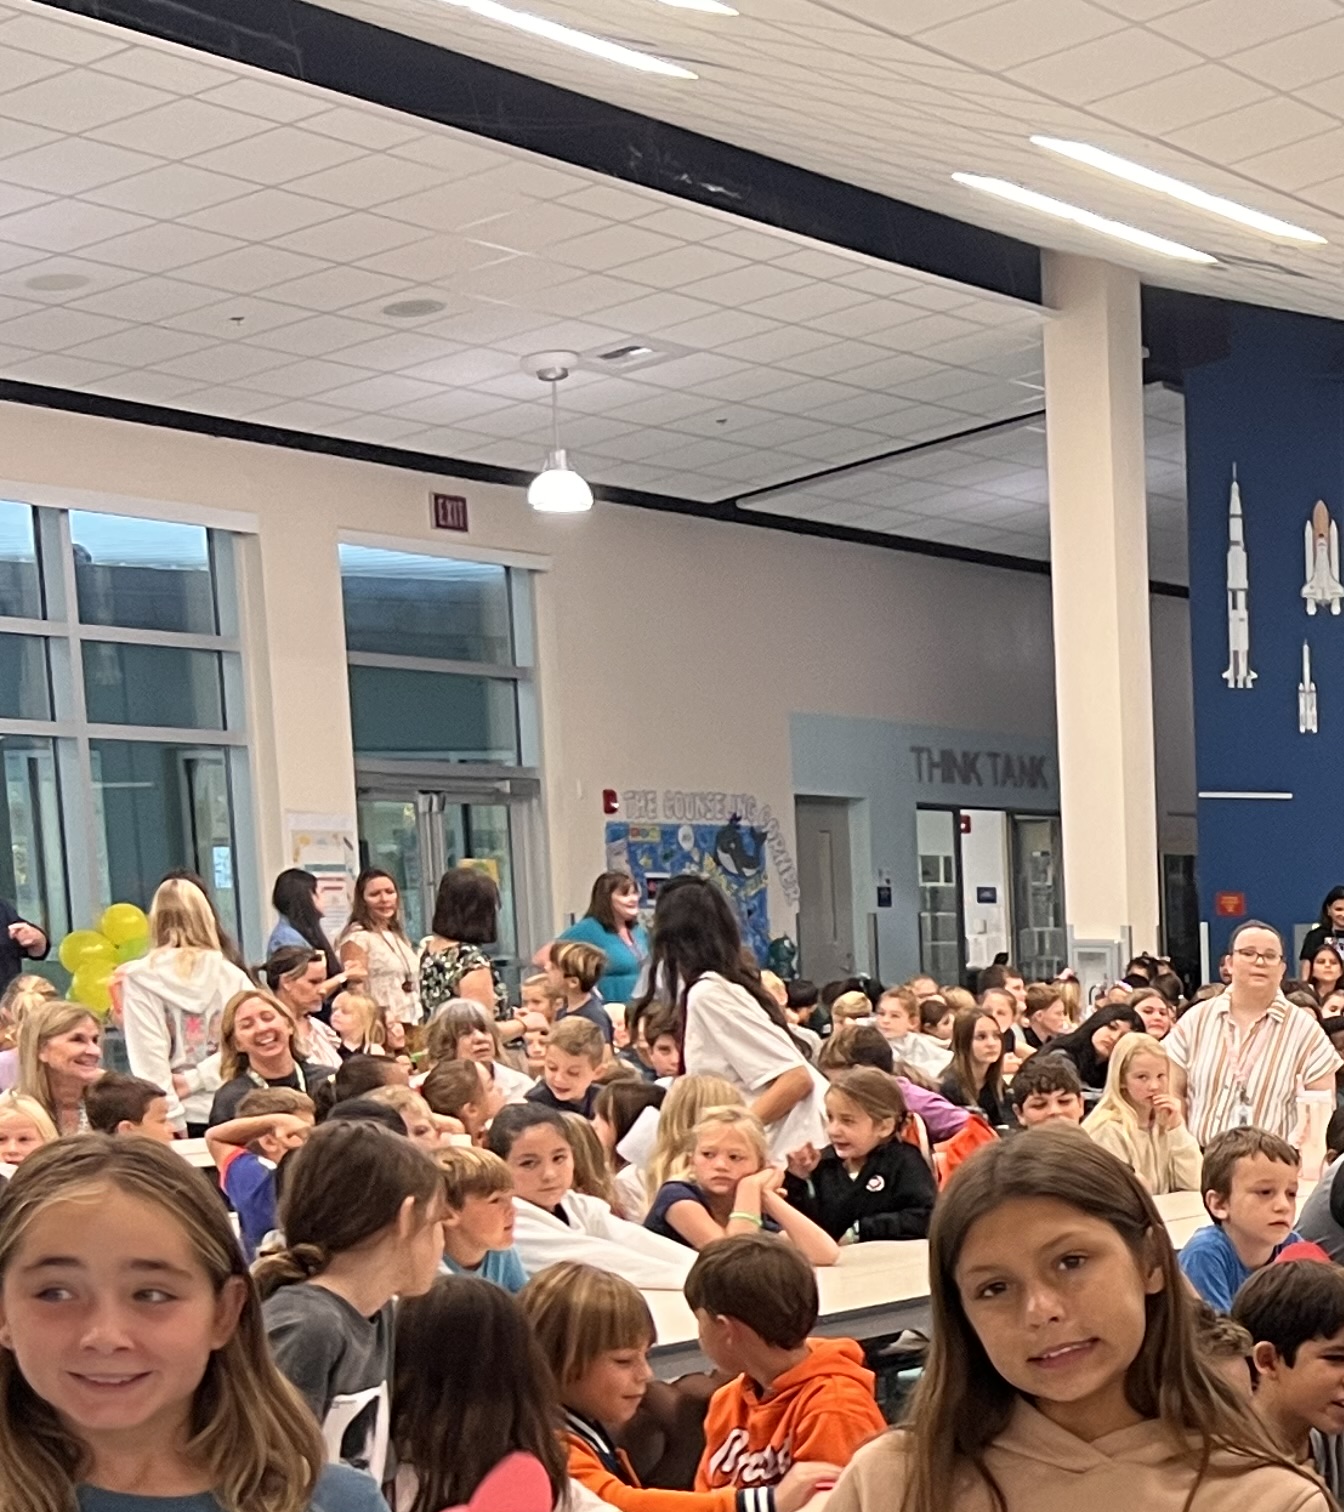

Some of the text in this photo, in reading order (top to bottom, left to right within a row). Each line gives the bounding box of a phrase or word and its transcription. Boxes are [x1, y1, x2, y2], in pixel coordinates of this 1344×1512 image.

[435, 496, 467, 529] EXIT
[910, 744, 1052, 791] THINK TANK
